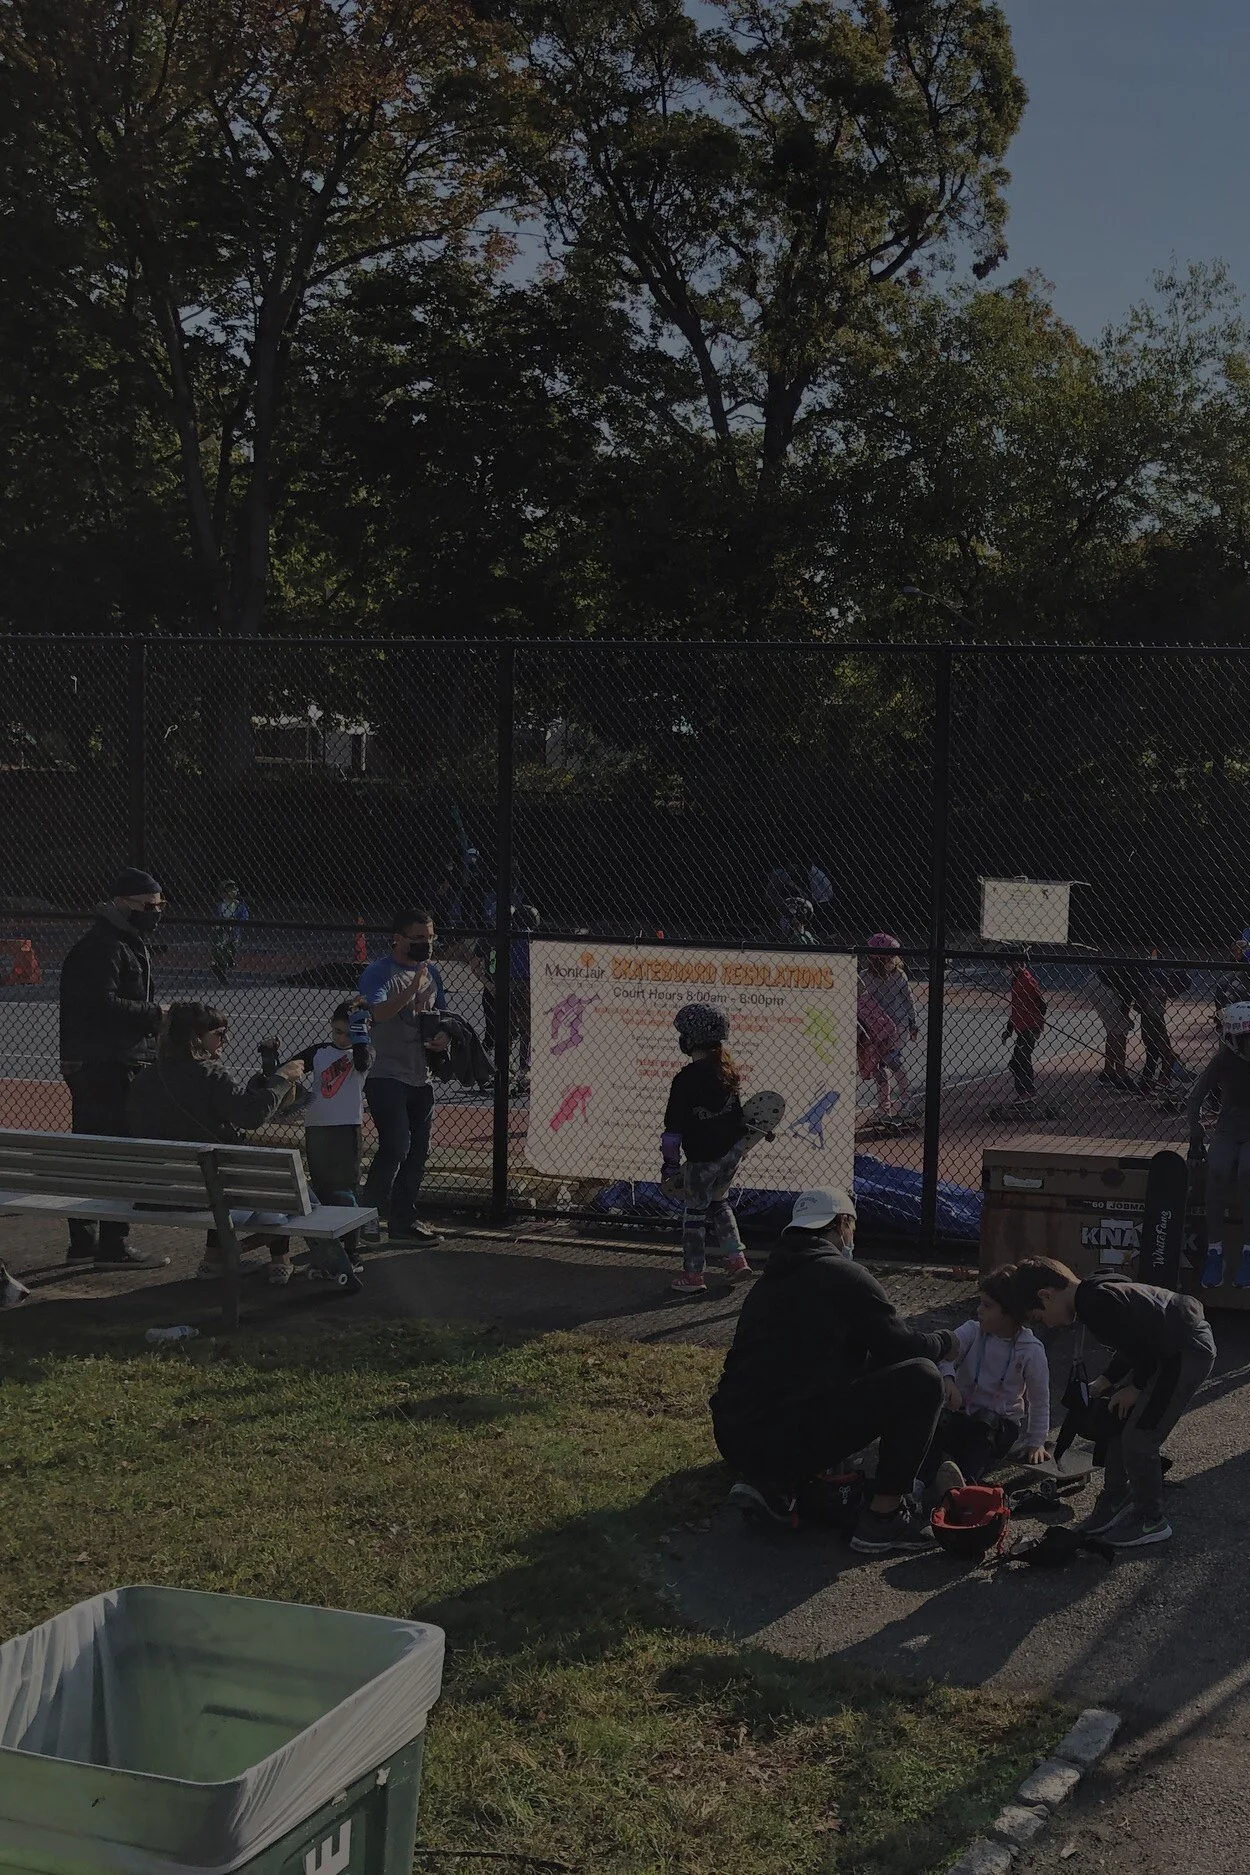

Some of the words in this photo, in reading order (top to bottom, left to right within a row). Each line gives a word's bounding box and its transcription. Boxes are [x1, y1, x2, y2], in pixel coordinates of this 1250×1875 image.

[545, 961, 605, 981] Montclair
[612, 956, 717, 985] SKATEBOARD
[721, 960, 834, 990] REGULATIONS
[613, 986, 646, 1000] Court
[648, 988, 684, 1001] Hours
[686, 990, 728, 1004] 8:00am
[739, 992, 785, 1008] 8:00pm
